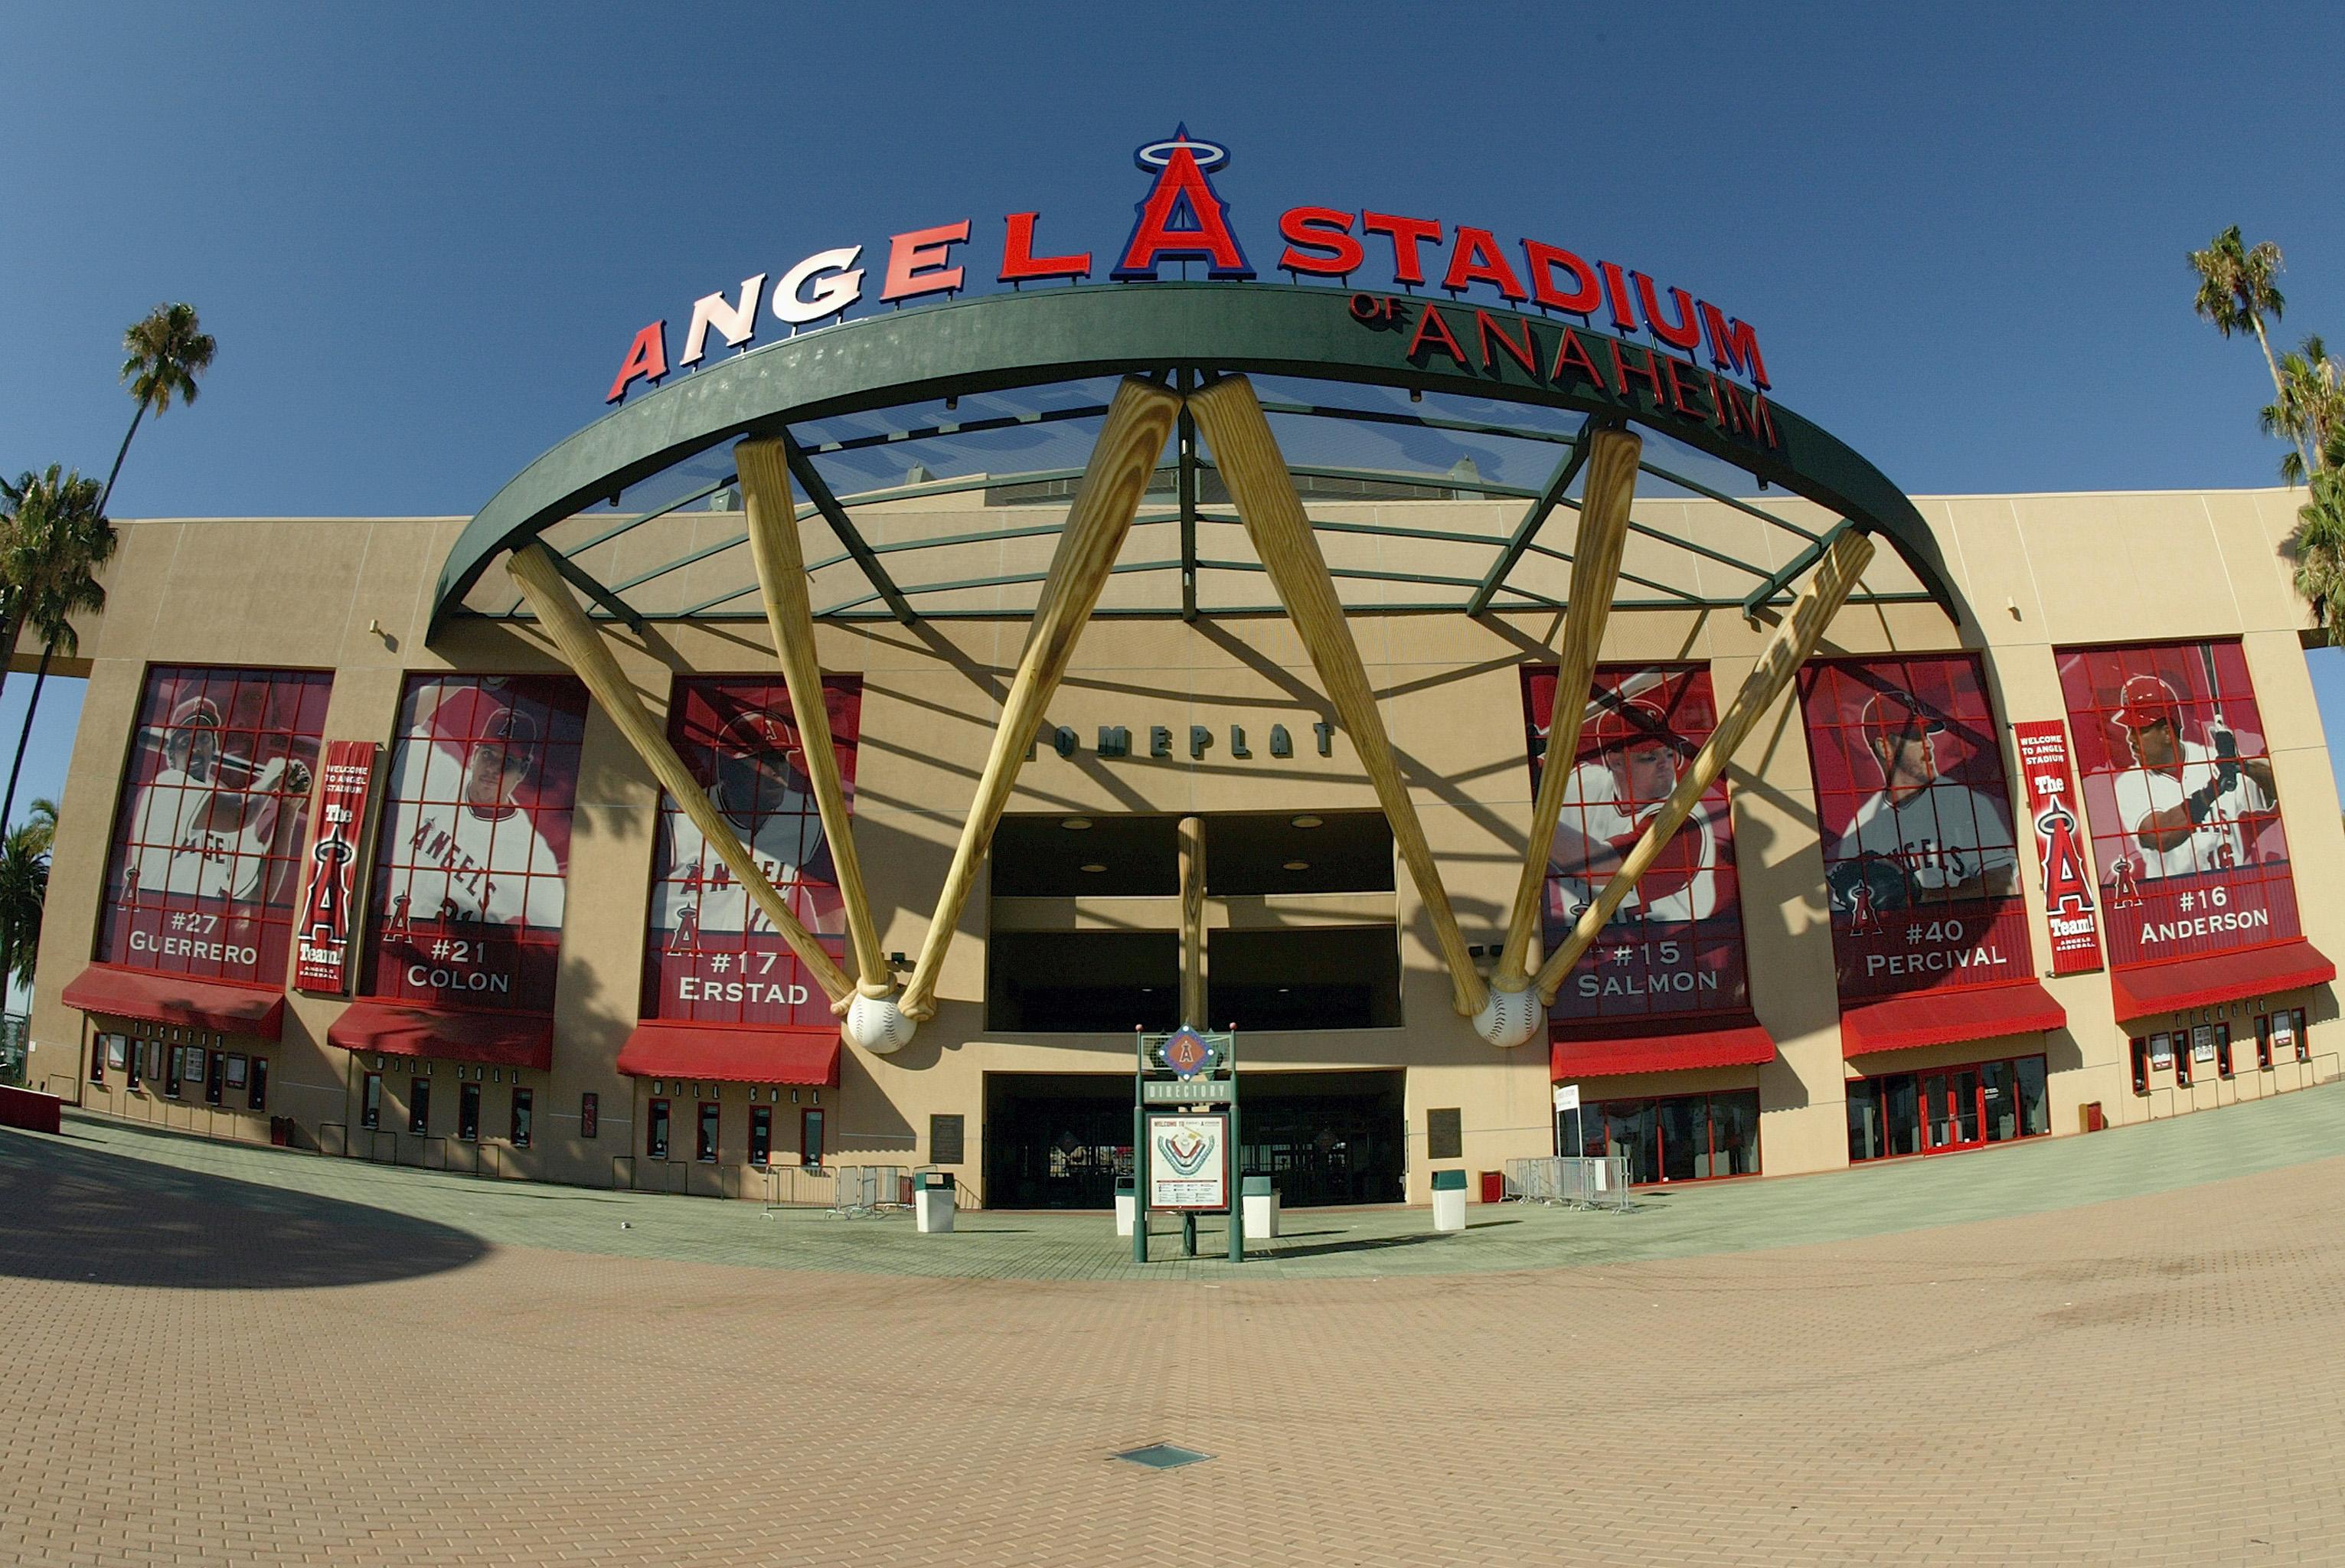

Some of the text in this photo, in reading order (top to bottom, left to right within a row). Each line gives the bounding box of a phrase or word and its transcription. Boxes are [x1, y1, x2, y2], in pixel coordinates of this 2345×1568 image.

[606, 211, 1092, 404] ANGEL
[1277, 206, 1772, 391] STADIUM
[1349, 292, 1778, 449] OF ANAHEIM
[1025, 723, 1329, 756] OMEPLAT
[2020, 735, 2062, 746] WELCOME
[2036, 744, 2065, 753] ANGEL
[326, 765, 367, 775] WELCOME
[2026, 755, 2064, 765] STADIUM
[325, 784, 363, 794] STADIUM
[338, 775, 366, 785] ANGEL
[2034, 775, 2065, 795] The
[325, 804, 352, 823] The
[2180, 886, 2228, 912] #16
[171, 911, 218, 934] #27
[1906, 920, 1964, 945] #40
[2049, 913, 2095, 937] Team!
[2140, 909, 2269, 945] ANDERSON
[129, 930, 257, 965] GUERRERO
[299, 942, 344, 965] Team!
[431, 939, 485, 963] #21
[1613, 941, 1680, 967] #15
[710, 951, 778, 975] #17
[1866, 946, 2007, 977] PERCIVAL
[407, 965, 509, 993] COLON
[679, 977, 808, 1004] ERSTAD
[1578, 970, 1717, 998] SALMON
[1150, 1085, 1225, 1098] DIRECTORY
